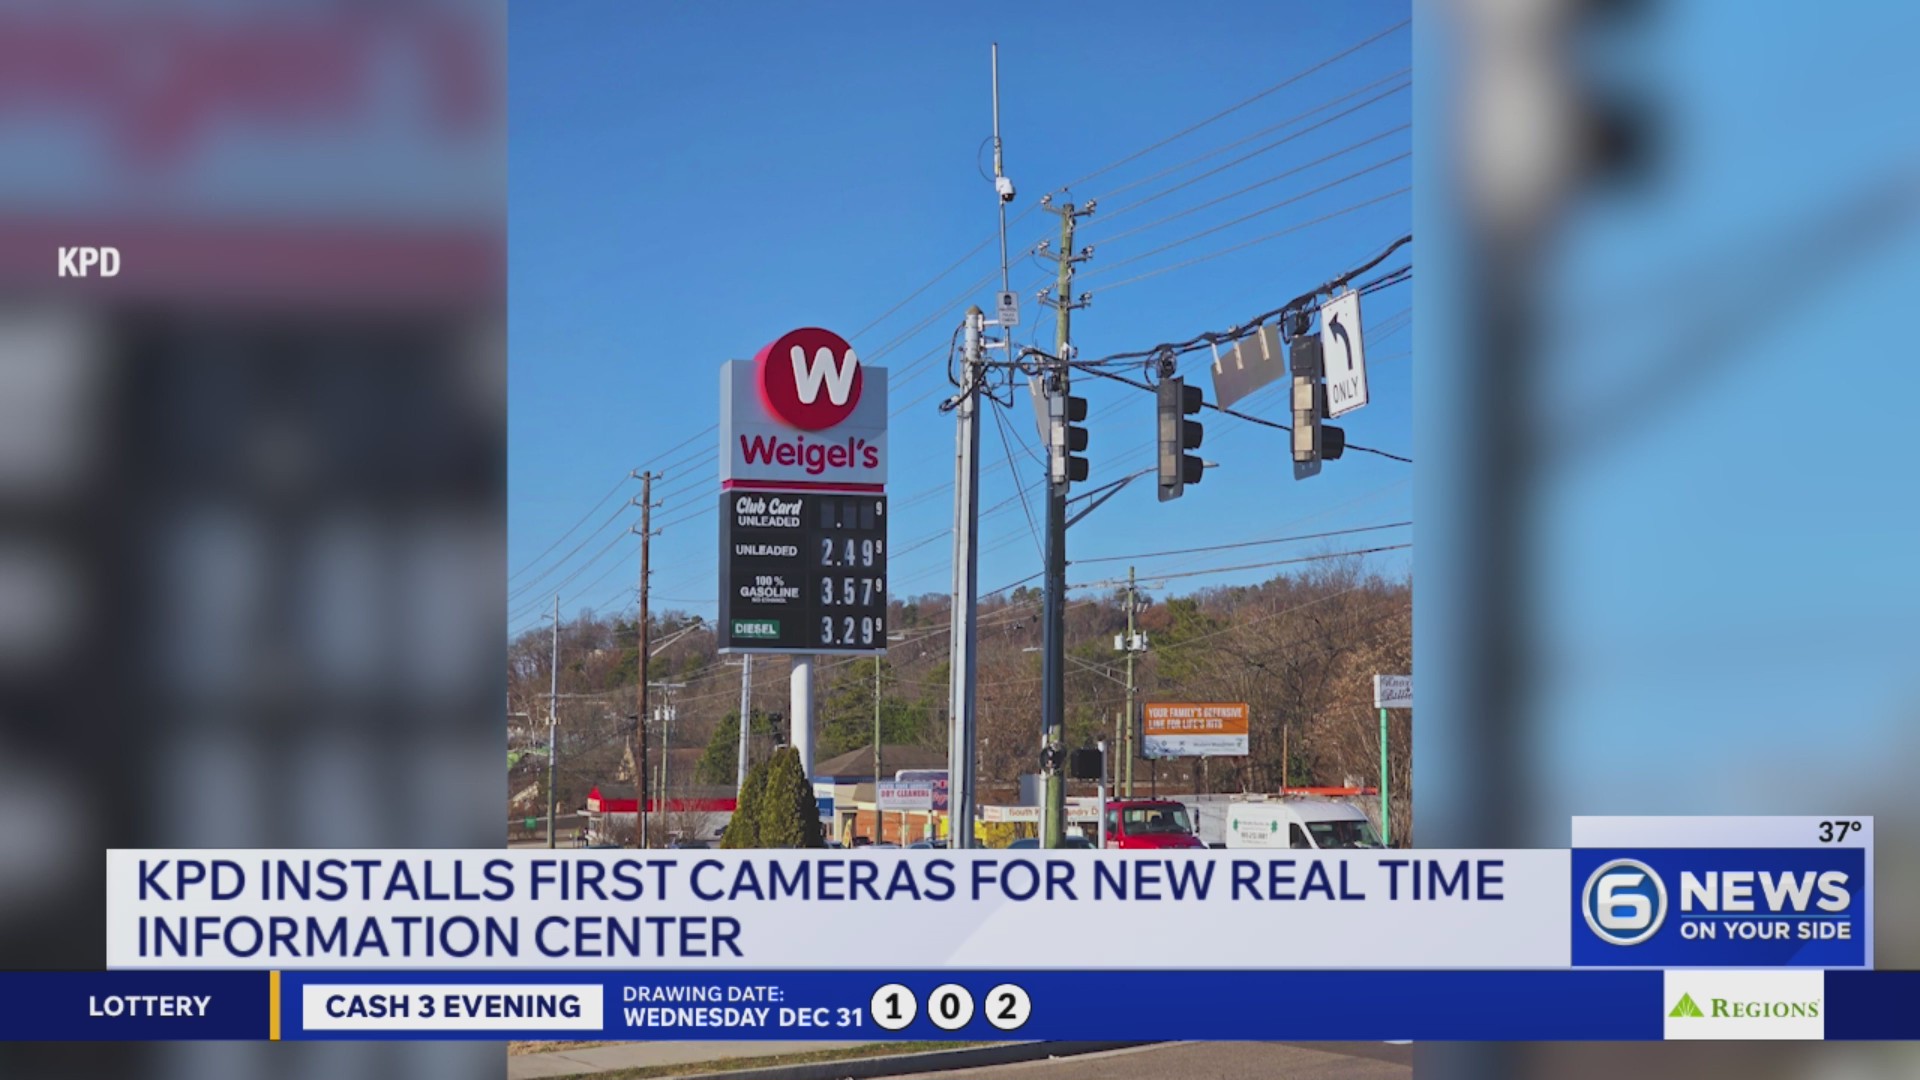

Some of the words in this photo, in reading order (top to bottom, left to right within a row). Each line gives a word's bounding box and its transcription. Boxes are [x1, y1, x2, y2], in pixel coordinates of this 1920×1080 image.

[790, 345, 858, 406] W
[1333, 376, 1359, 404] ONLY
[740, 434, 879, 475] Weigel's
[736, 497, 765, 514] Club
[768, 498, 802, 515] Card
[738, 516, 800, 527] UNLEADED
[736, 544, 798, 556] UNLEADED
[740, 586, 800, 598] GASOLINE
[735, 623, 777, 635] DIESEL
[1149, 707, 1169, 718] YOUR
[1167, 719, 1181, 729] FOR
